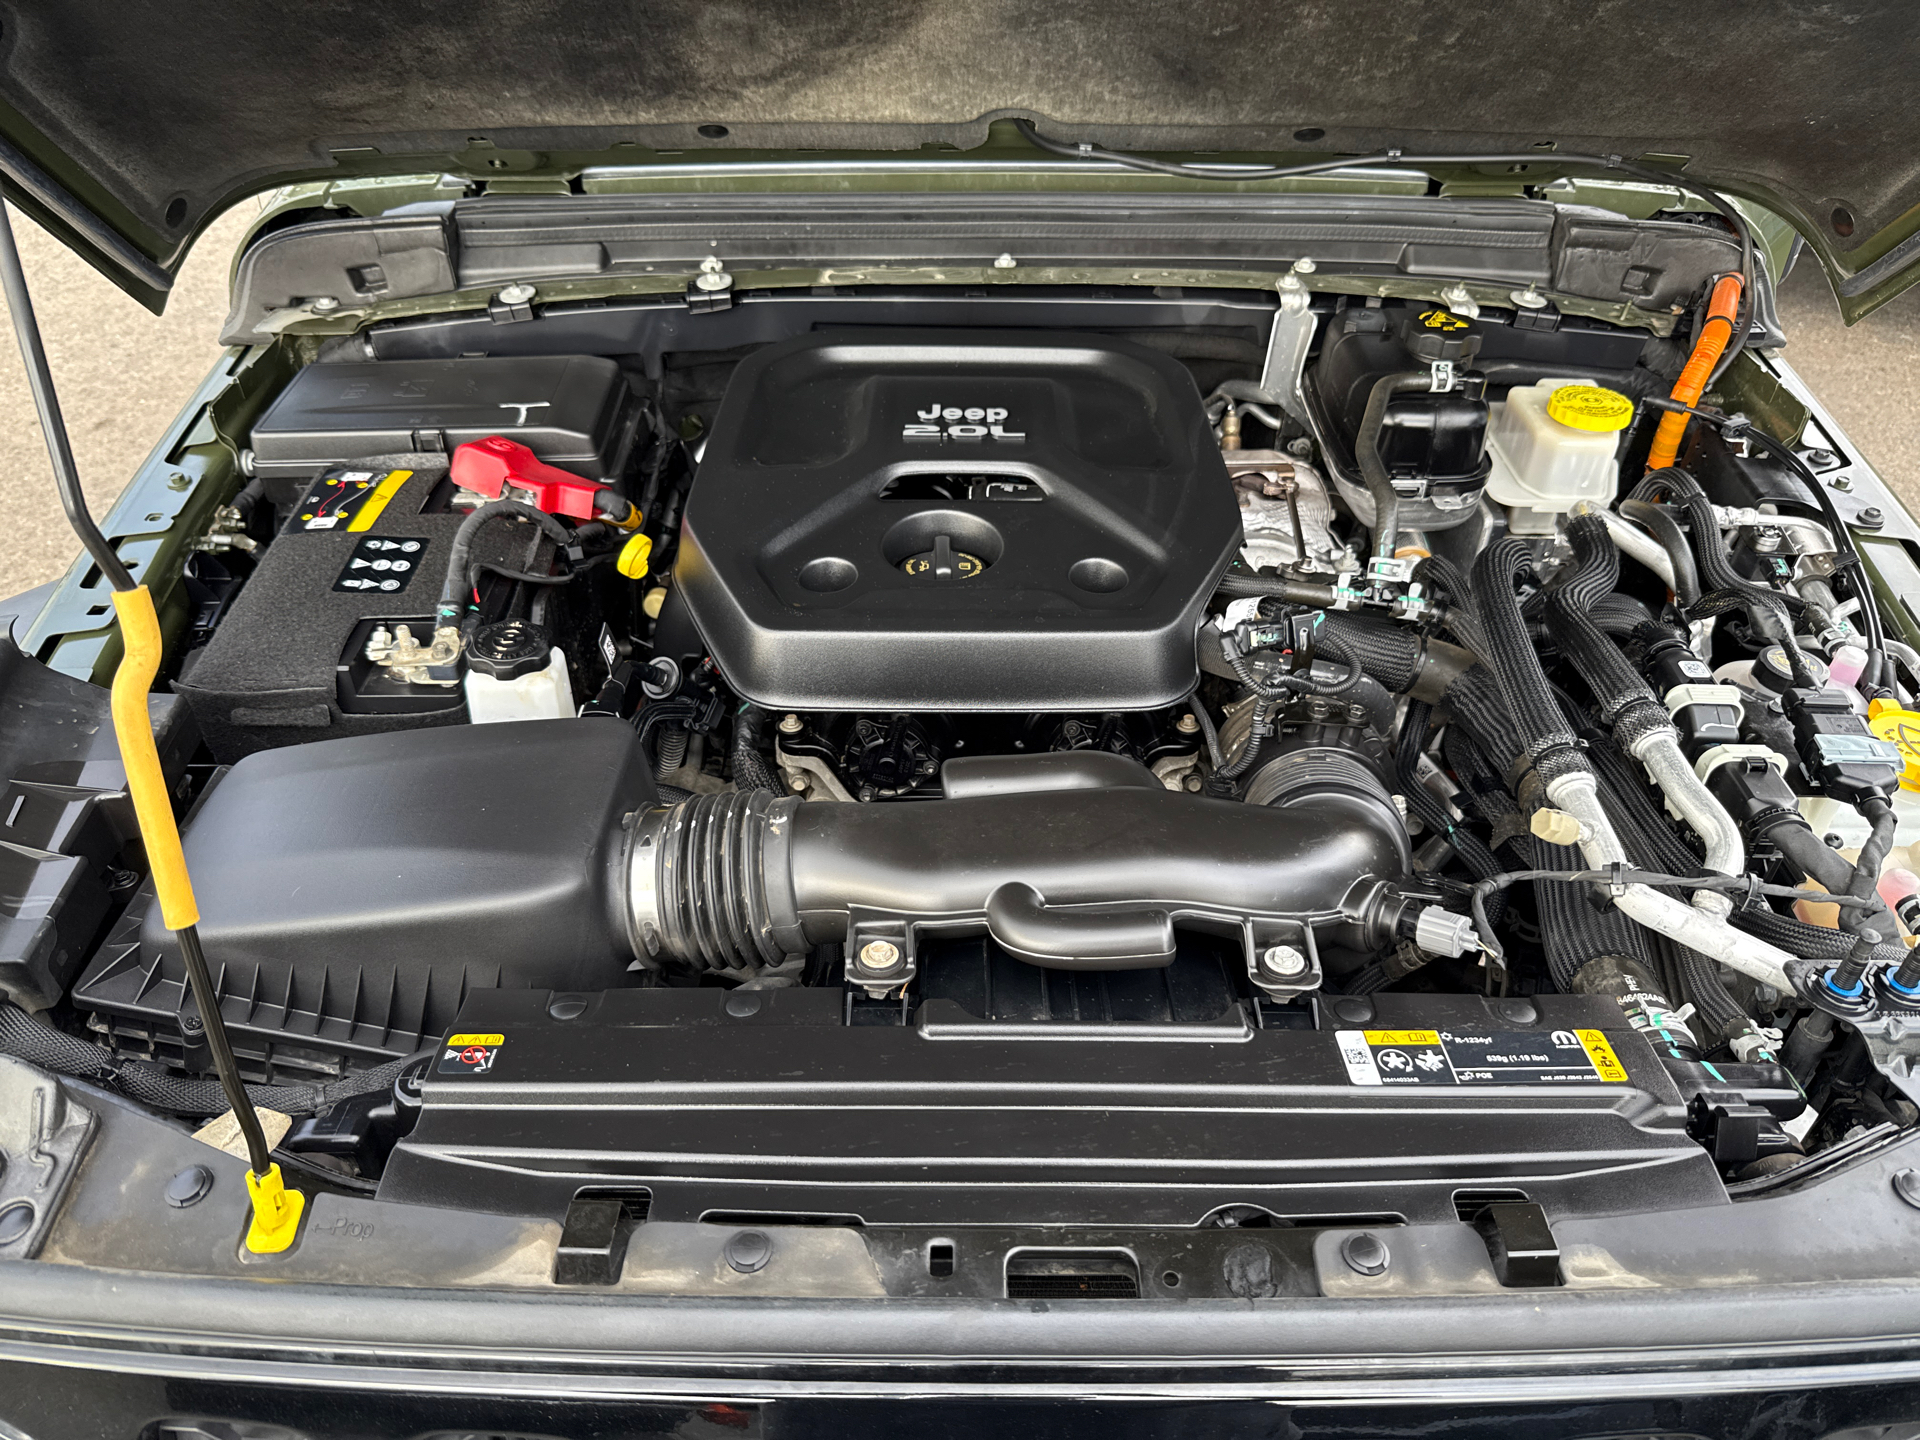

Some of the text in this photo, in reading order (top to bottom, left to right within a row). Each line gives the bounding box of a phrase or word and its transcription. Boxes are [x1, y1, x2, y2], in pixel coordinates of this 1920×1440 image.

[917, 403, 1009, 424] Jeep
[902, 424, 1026, 440] 2.0L
[1623, 974, 1640, 991] PHEV
[1454, 1036, 1493, 1045] R-1234yf
[1532, 1054, 1550, 1063] lbs)
[331, 1217, 375, 1242] Prop
